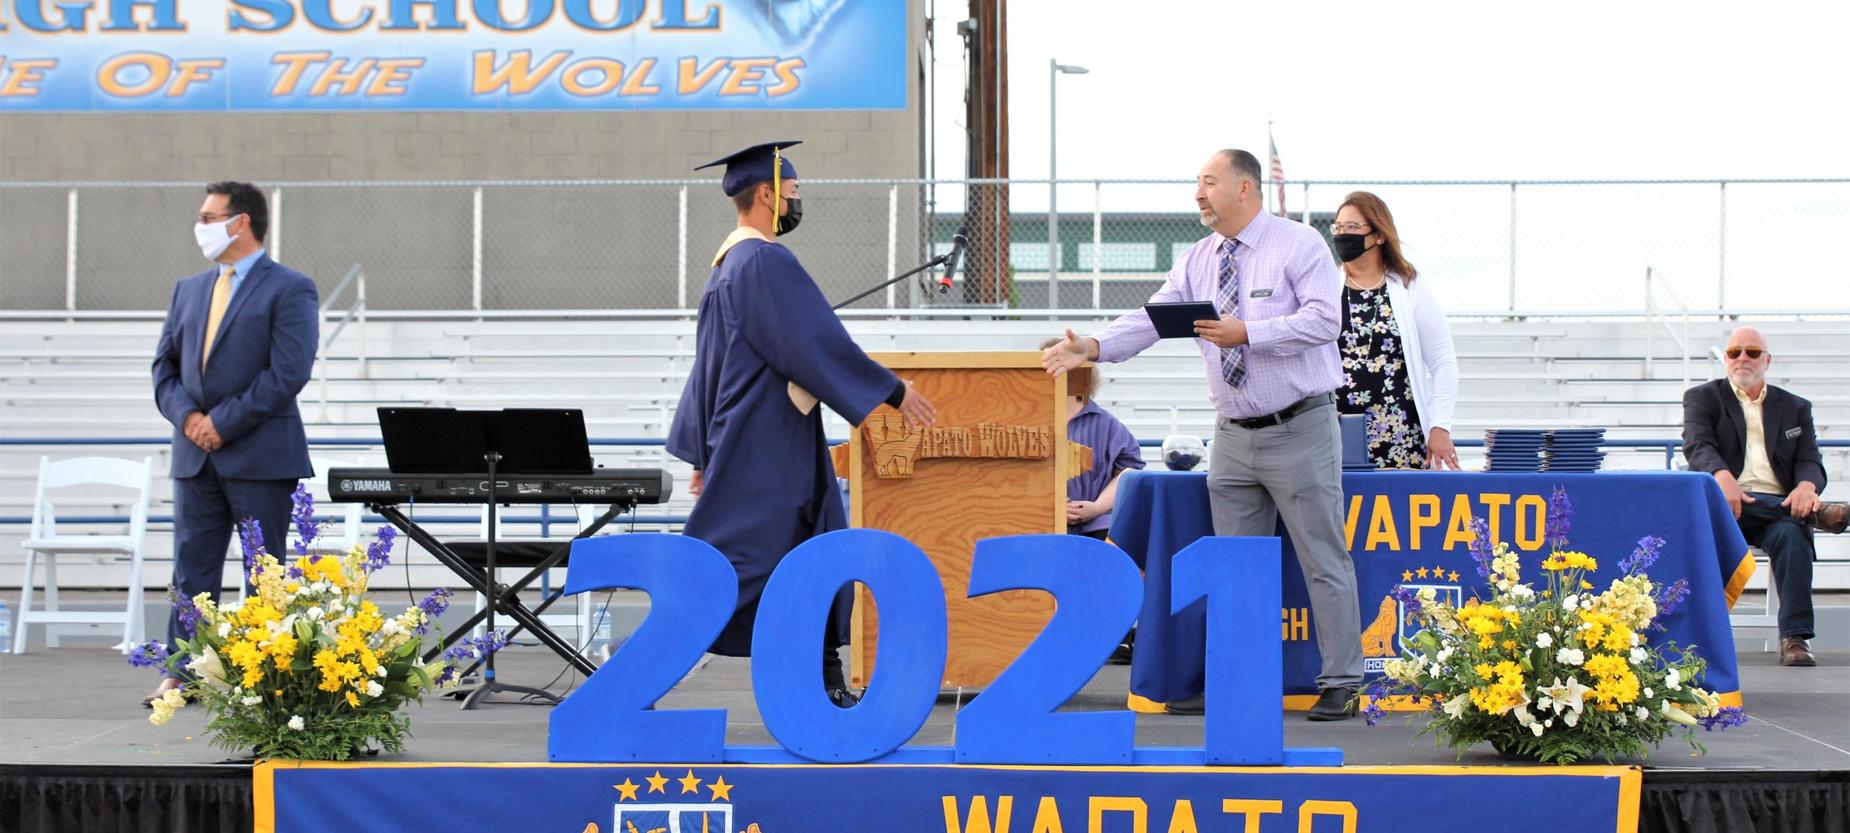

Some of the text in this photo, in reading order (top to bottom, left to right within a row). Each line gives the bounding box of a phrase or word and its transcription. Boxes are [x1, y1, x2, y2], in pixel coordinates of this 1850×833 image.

[227, 0, 722, 33] SCHOOL
[270, 51, 427, 97] THE
[471, 49, 807, 97] WOLVES
[977, 423, 1050, 458] WOLVES
[353, 480, 391, 491] YAMAHA
[548, 529, 1283, 766] 2021
